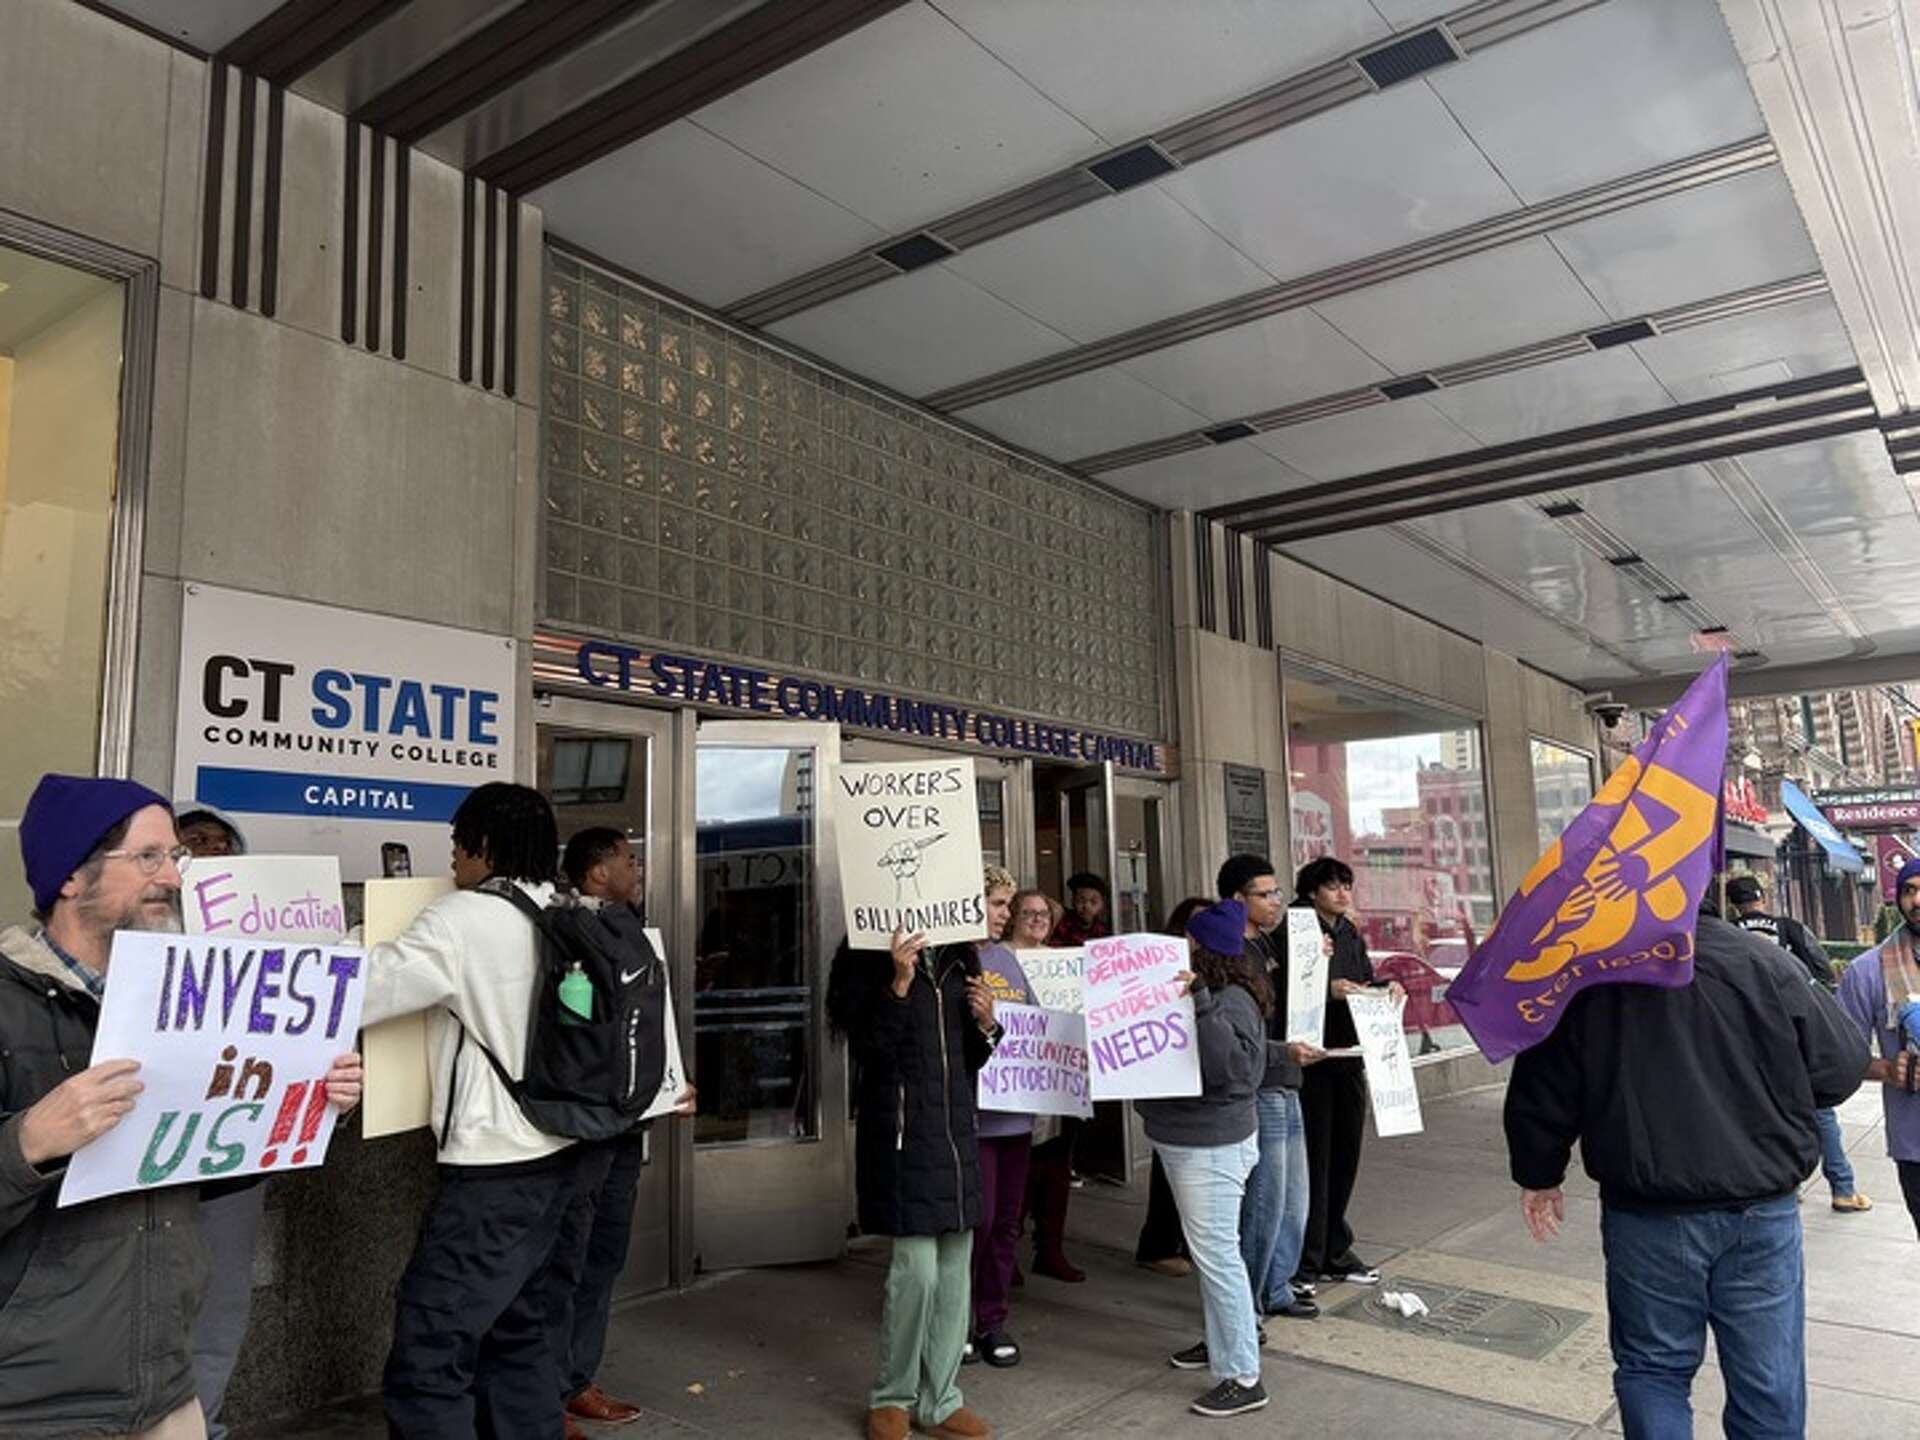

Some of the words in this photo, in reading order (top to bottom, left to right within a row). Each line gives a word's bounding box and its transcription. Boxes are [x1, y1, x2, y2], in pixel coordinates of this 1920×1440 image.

[203, 655, 295, 722] CT
[312, 668, 499, 745] STATE
[578, 640, 640, 690] CT
[651, 652, 772, 712] STATE
[778, 676, 967, 743] COMMUNITY
[977, 713, 1082, 759] COLLEGE
[1082, 731, 1160, 773] CAPITAL
[204, 726, 379, 757] COMMUNITY
[391, 744, 498, 768] COLLEGE
[304, 786, 414, 810] CAPITAL
[839, 768, 962, 797] WORKERS
[864, 805, 940, 829] OVER
[1834, 807, 1918, 820] Residence
[194, 873, 344, 934] Education
[854, 893, 985, 933] BILLIONAIRES
[1088, 944, 1180, 985] DEMANDS
[1090, 941, 1130, 960] OUR
[155, 945, 361, 1039] INVEST
[1091, 1012, 1188, 1074] NEEDS
[205, 1045, 273, 1101] in
